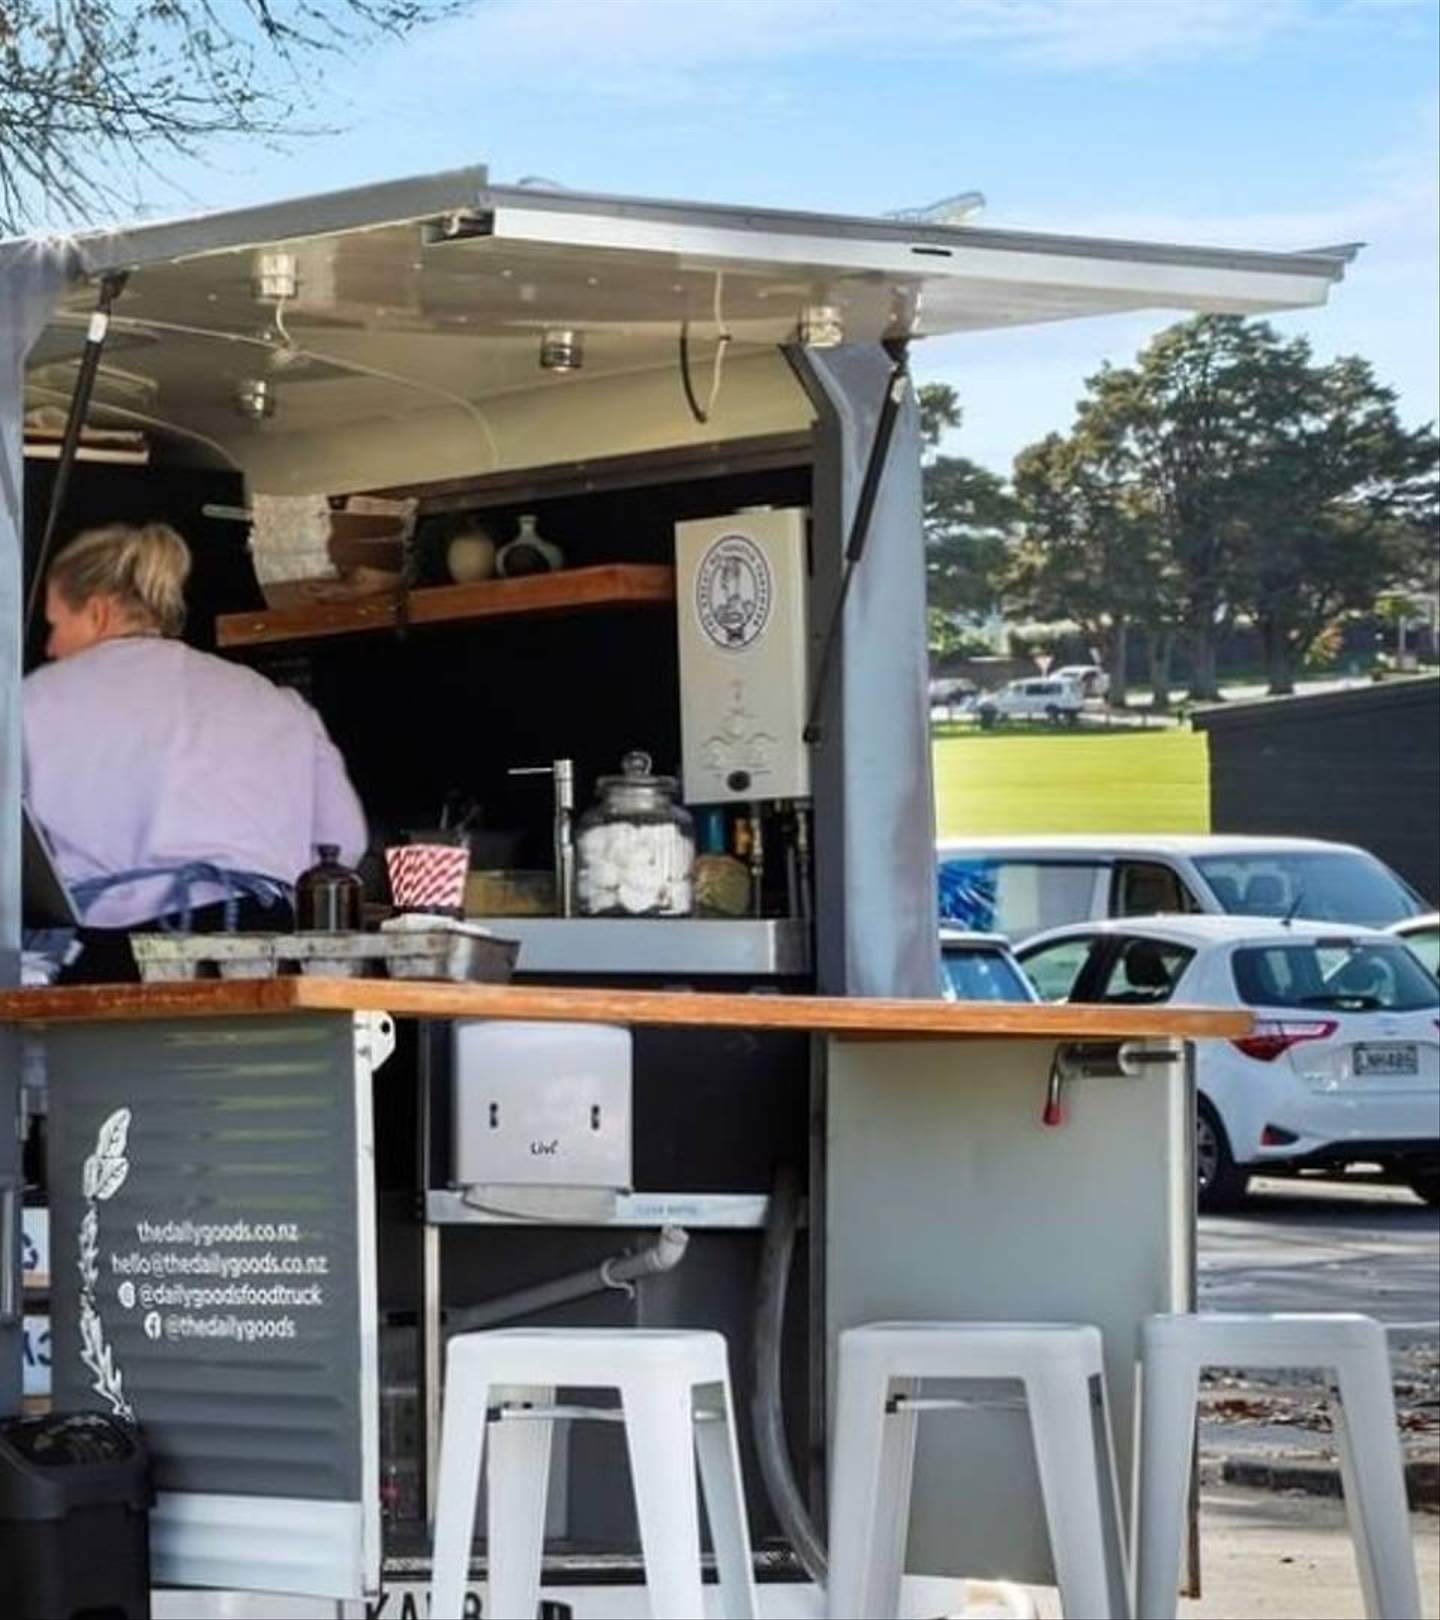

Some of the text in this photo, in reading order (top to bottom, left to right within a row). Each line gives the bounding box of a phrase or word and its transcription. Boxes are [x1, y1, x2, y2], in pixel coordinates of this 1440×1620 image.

[136, 1219, 299, 1247] thedailygoods.co.nz
[111, 1251, 329, 1279] hello@thedailygoods.co.nz
[138, 1282, 323, 1310] @dailygoodsfoodtruck
[164, 1313, 296, 1342] @thedailygoods
